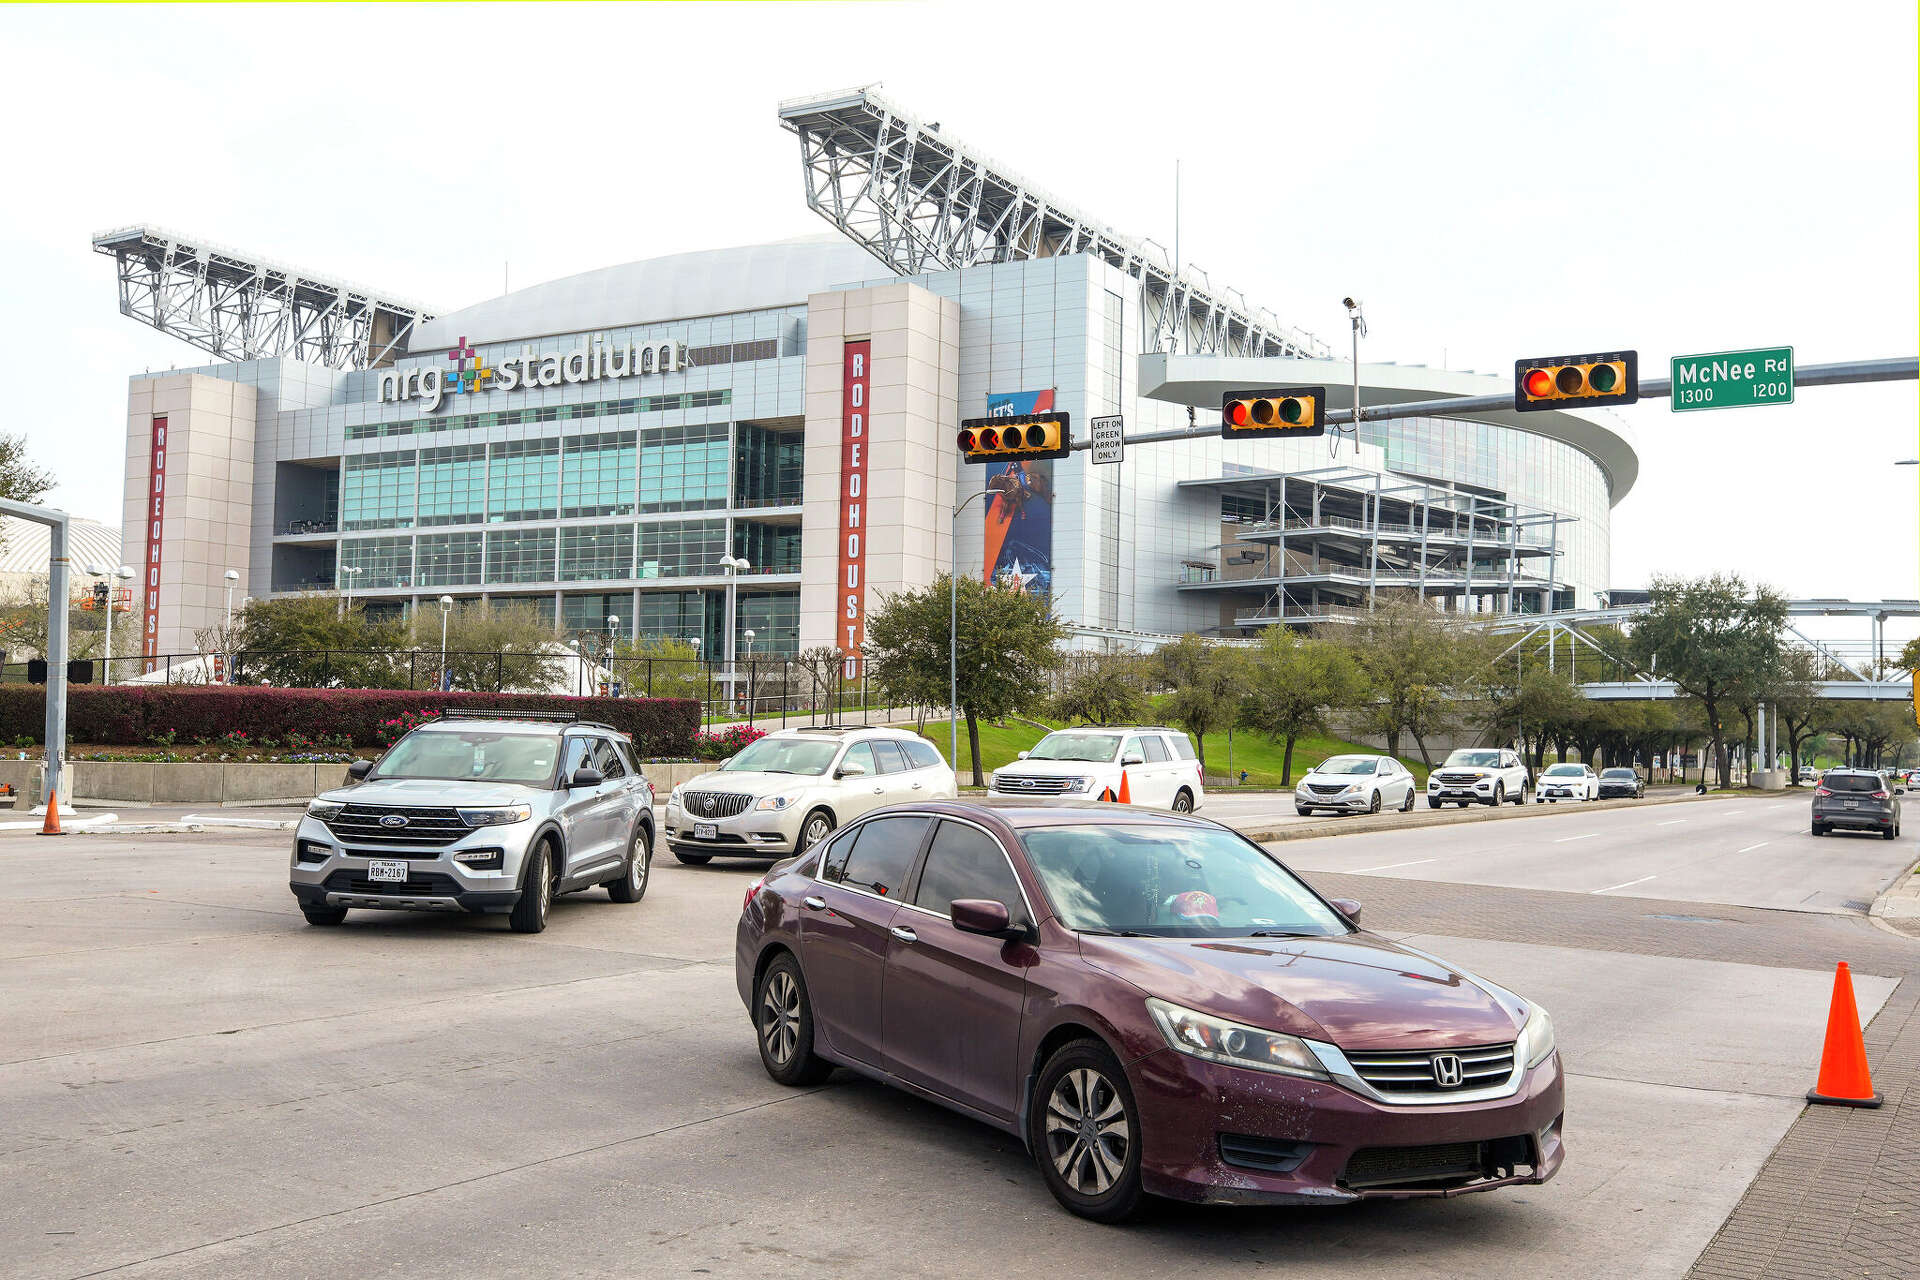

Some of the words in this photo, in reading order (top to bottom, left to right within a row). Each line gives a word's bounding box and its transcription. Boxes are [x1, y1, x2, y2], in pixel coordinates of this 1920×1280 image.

[377, 363, 444, 412] nrg
[497, 333, 681, 391] stadium
[1679, 360, 1756, 385] McNee
[1764, 358, 1787, 373] Rd
[1680, 387, 1713, 404] 1300
[1752, 381, 1787, 398] 1200
[1093, 421, 1110, 430] LEFT
[1111, 420, 1121, 428] ON
[1095, 430, 1120, 440] GREEN
[1095, 440, 1120, 450] ARROW
[1098, 450, 1117, 460] ONLY
